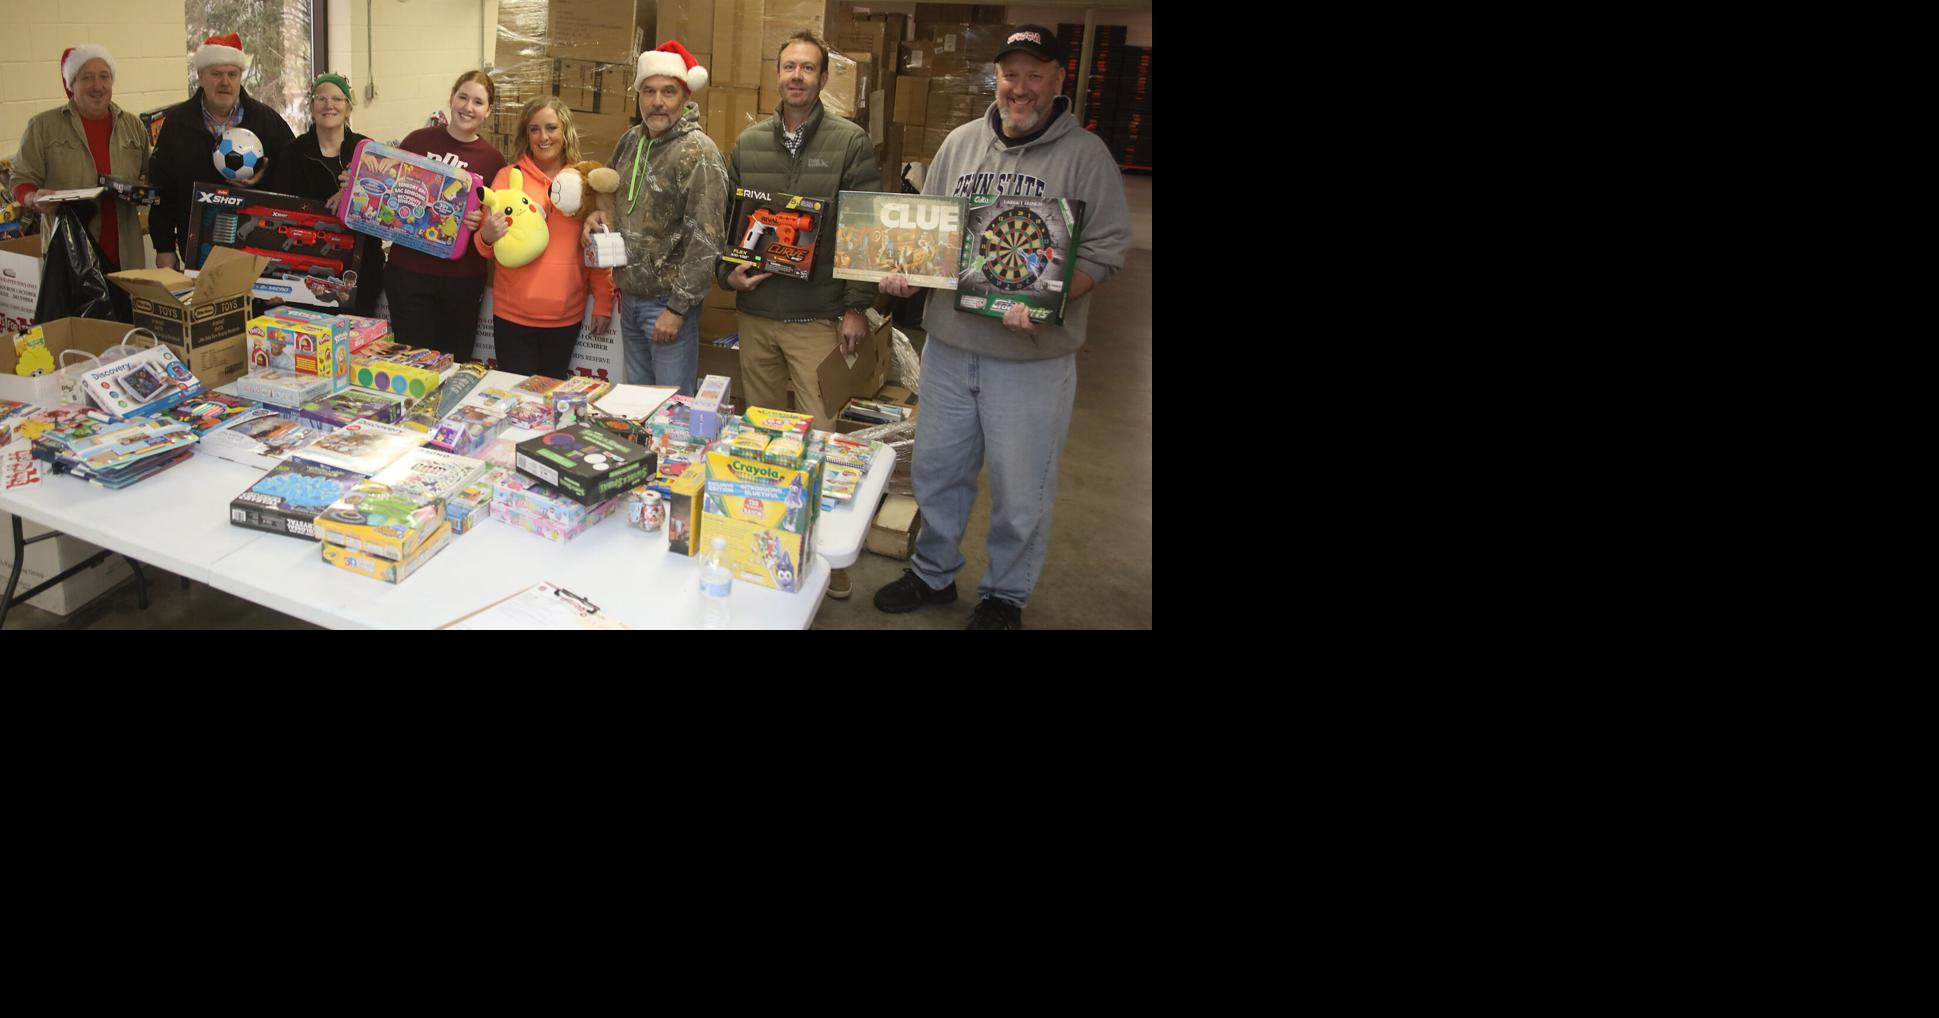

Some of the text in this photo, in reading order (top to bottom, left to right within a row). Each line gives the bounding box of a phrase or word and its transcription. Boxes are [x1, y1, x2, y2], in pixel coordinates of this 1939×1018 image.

[953, 172, 1046, 196] PENN STATE
[743, 189, 772, 201] RIVAL
[880, 202, 959, 232] CLUE
[768, 243, 808, 260] CURVE
[159, 305, 178, 318] TOYS
[221, 300, 238, 312] TOYS
[585, 334, 614, 344] OCTOBER
[585, 354, 611, 364] RESERVE
[91, 362, 131, 380] Discovery
[732, 460, 779, 479] Crayola
